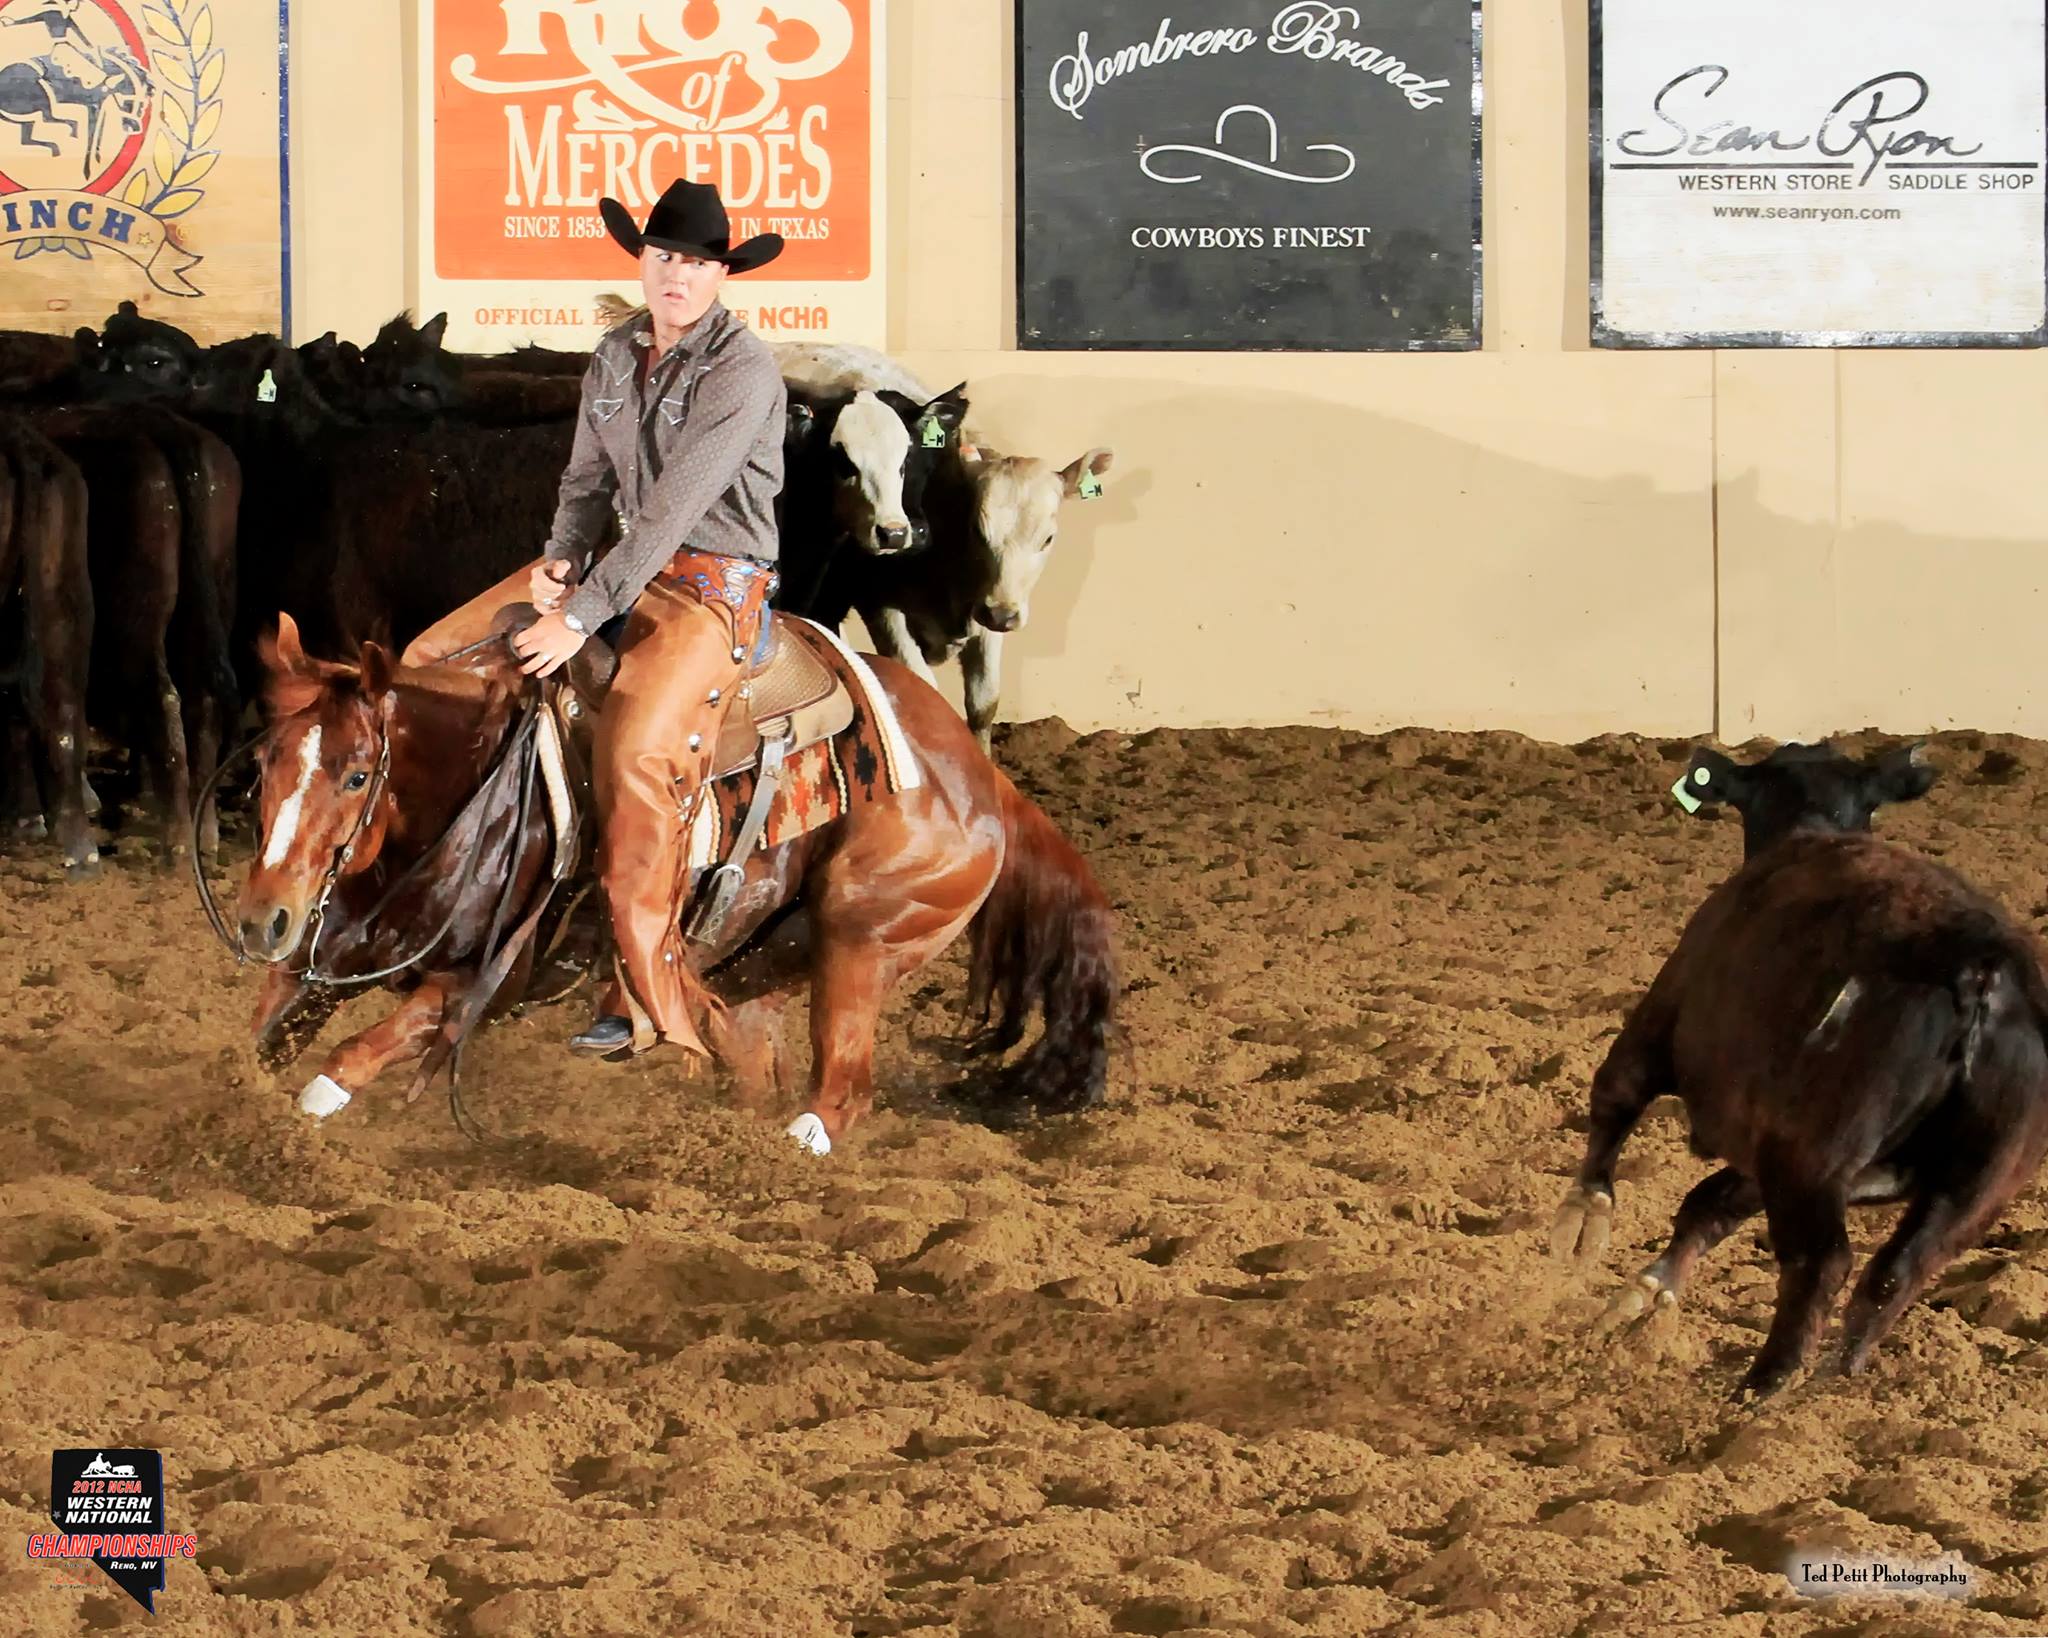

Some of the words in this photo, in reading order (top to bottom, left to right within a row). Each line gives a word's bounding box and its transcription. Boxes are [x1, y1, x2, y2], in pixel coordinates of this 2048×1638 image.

[1049, 17, 1258, 121] Sombrero
[1266, 0, 1450, 111] Brands
[681, 50, 743, 132] of
[1616, 64, 1811, 157] Sean
[1816, 70, 1983, 188] Ryon
[1679, 174, 1777, 191] WESTERN
[1786, 174, 1853, 191] STORE
[1888, 174, 1968, 190] SADDLE
[1978, 173, 2035, 190] SHOP
[1713, 204, 1901, 222] www.seanryon.com
[504, 216, 561, 239] SINCE
[567, 216, 606, 239] 1853
[740, 217, 762, 239] IN
[767, 217, 830, 240] TEXAS
[1131, 226, 1265, 249] COWBOYS
[1272, 226, 1371, 249] FINEST
[474, 307, 584, 326] OFFICIAL
[758, 306, 829, 330] NCHA
